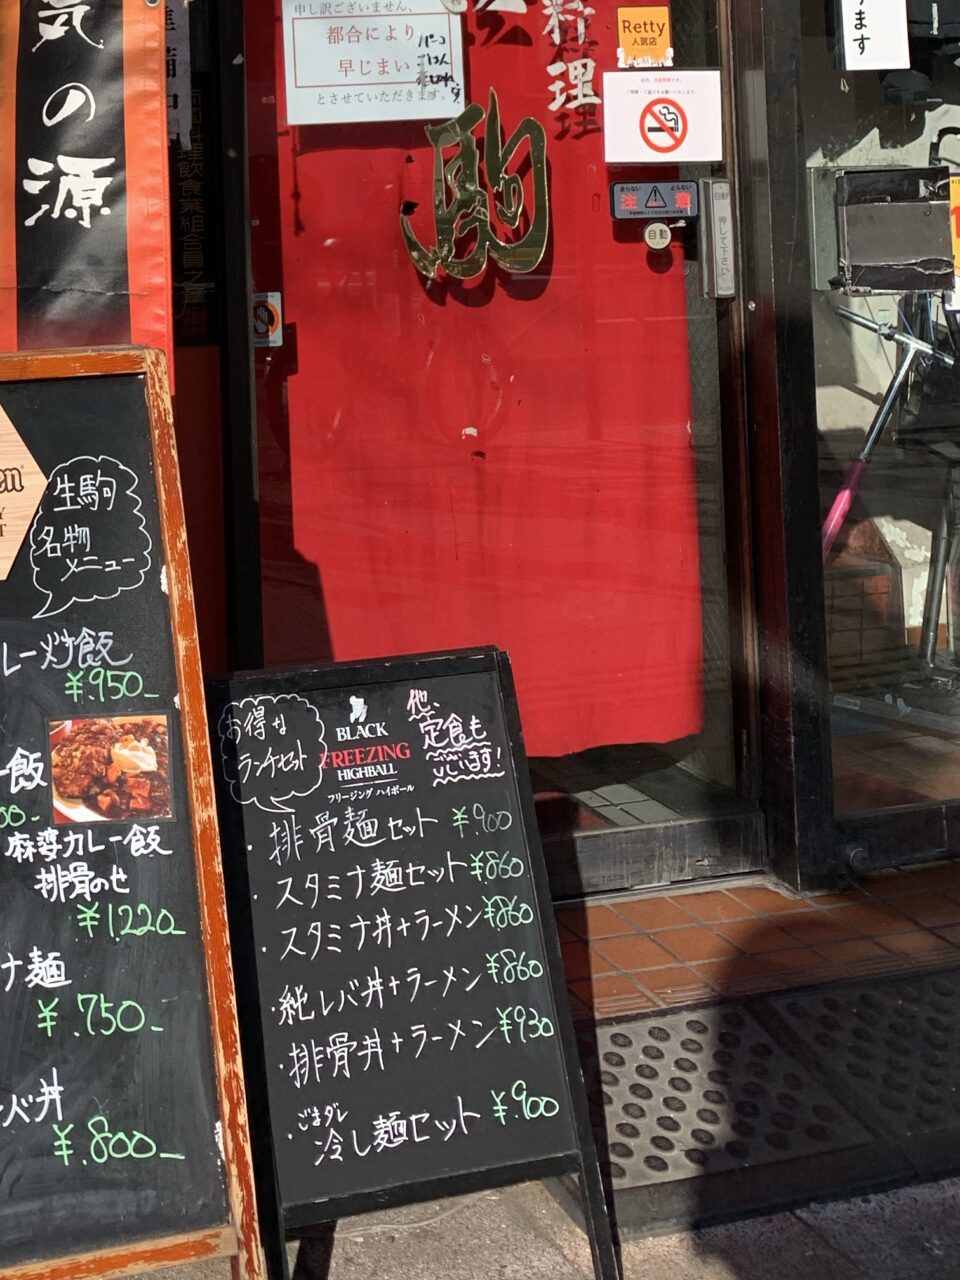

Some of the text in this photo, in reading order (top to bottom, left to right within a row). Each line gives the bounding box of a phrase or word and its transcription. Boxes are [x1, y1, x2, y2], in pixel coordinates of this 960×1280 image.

[326, 23, 415, 46] 都合により
[621, 19, 666, 37] Retty
[631, 36, 658, 47] 人気店
[338, 57, 410, 78] 早じまい
[53, 469, 117, 512] 生駒
[33, 523, 90, 558] 名物
[60, 556, 136, 583] メニュー
[224, 705, 287, 744] お得な
[335, 721, 389, 742] BLACK
[419, 712, 488, 749] 定食も
[237, 739, 308, 784] ランチセット
[319, 742, 412, 770] FREEZING
[336, 763, 398, 782] HIGHBALL
[327, 787, 375, 804] フリージング
[3, 823, 174, 863] 麻婆カレー飯
[268, 806, 438, 866] 排骨麺セット
[33, 861, 130, 903] 排骨のせ
[275, 850, 468, 910] スタミナ麺セット
[314, 1095, 481, 1166] 冷し麺セット
